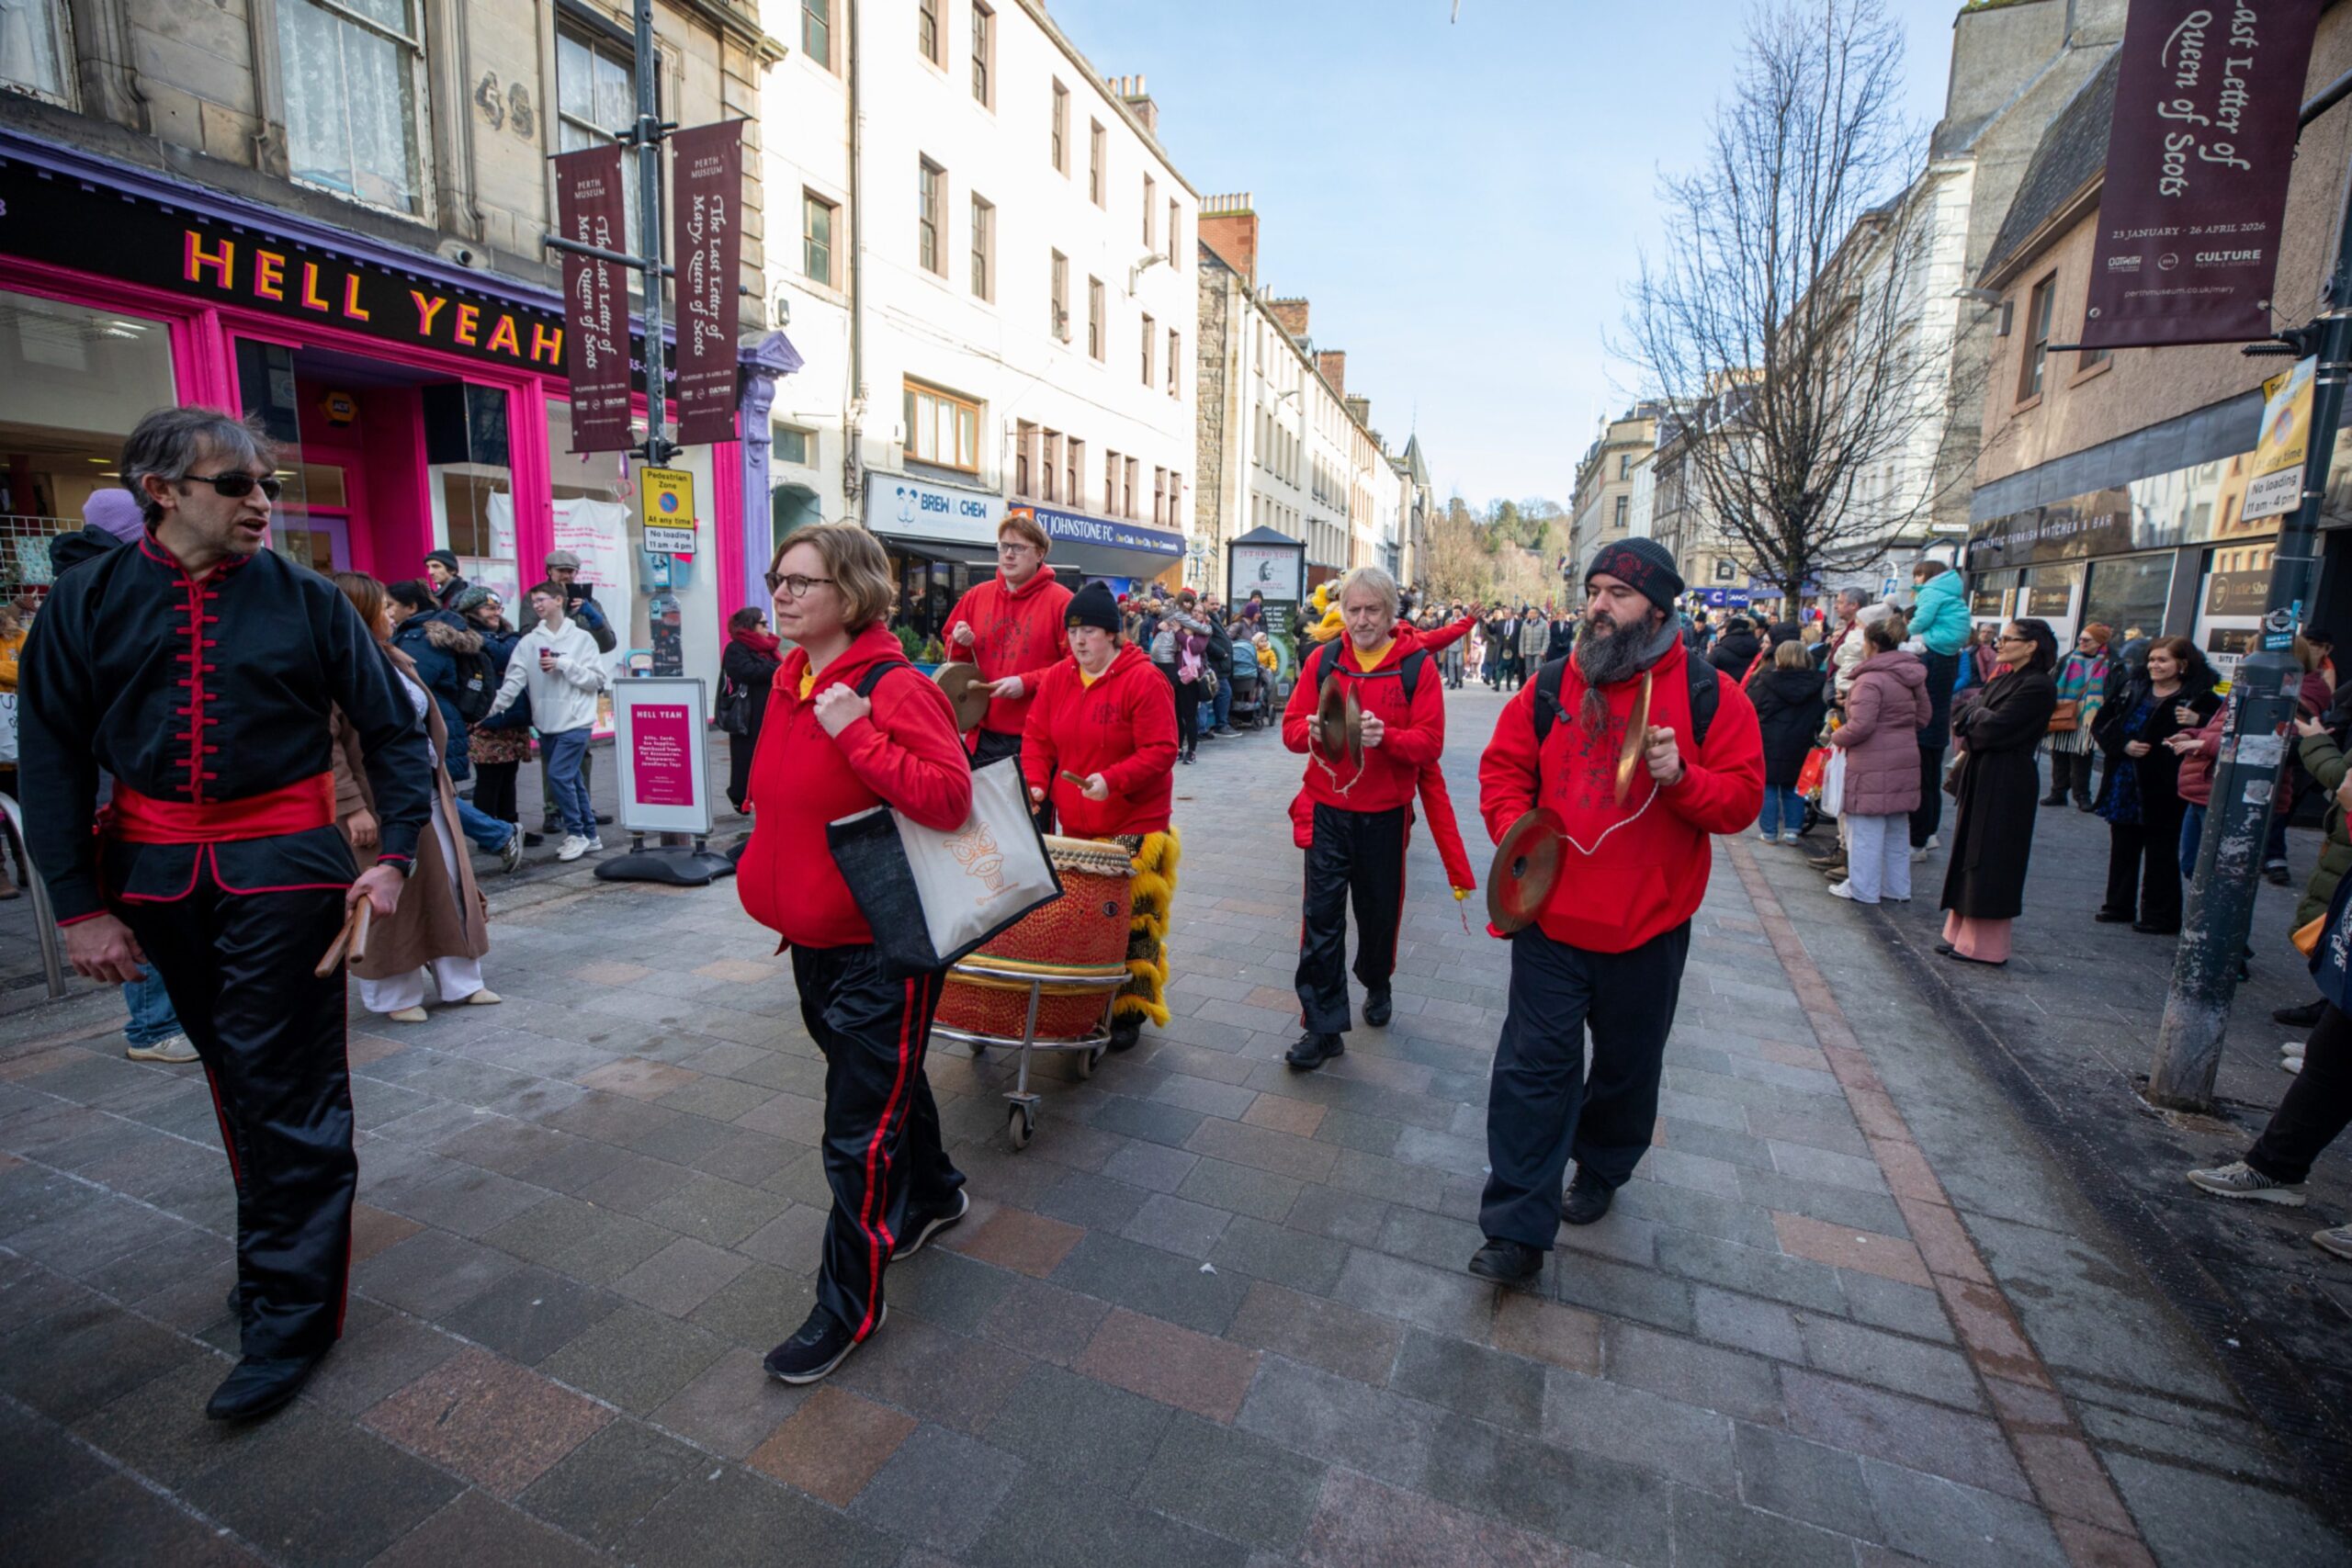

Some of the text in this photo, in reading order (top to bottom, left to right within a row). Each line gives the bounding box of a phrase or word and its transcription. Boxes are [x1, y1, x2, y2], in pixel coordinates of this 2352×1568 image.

[2199, 0, 2259, 171] ast Letter of
[2157, 9, 2212, 197] Queen of Scots
[695, 156, 719, 168] PERTH
[691, 165, 722, 179] MUSEUM
[574, 187, 605, 199] MUSEUM
[577, 178, 601, 191] PERTH
[2113, 231, 2124, 239] 23
[2125, 227, 2179, 241] JANUARY
[2190, 226, 2202, 235] 26
[2205, 224, 2237, 234] APRIL
[2240, 222, 2266, 231] 2026
[2195, 249, 2262, 262] CULTURE
[688, 250, 704, 294] Queen
[705, 195, 727, 341] The Last Letter of
[577, 268, 593, 310] Queen
[2125, 286, 2235, 299] perthmuseum.co.uk/mary
[184, 230, 563, 366] HELL YEAH
[599, 293, 612, 335] Letter
[690, 300, 709, 316] of
[580, 316, 599, 331] of
[694, 319, 705, 356] Scots
[584, 333, 598, 370] Scots
[597, 339, 617, 355] of
[2284, 448, 2302, 463] time
[647, 470, 688, 482] Pedestrian
[2252, 474, 2296, 495] No loading
[658, 481, 677, 490] Zone
[921, 493, 950, 513] BREW
[960, 499, 986, 519] CHEW
[664, 530, 690, 541] loading
[1036, 513, 1114, 541] ST JOHNSTONE FC
[1971, 536, 2005, 551] AUTHENTIC
[2008, 530, 2038, 545] TURKISH
[2041, 521, 2077, 539] KITCHEN
[2092, 514, 2113, 530] BAR
[637, 711, 656, 719] HELL
